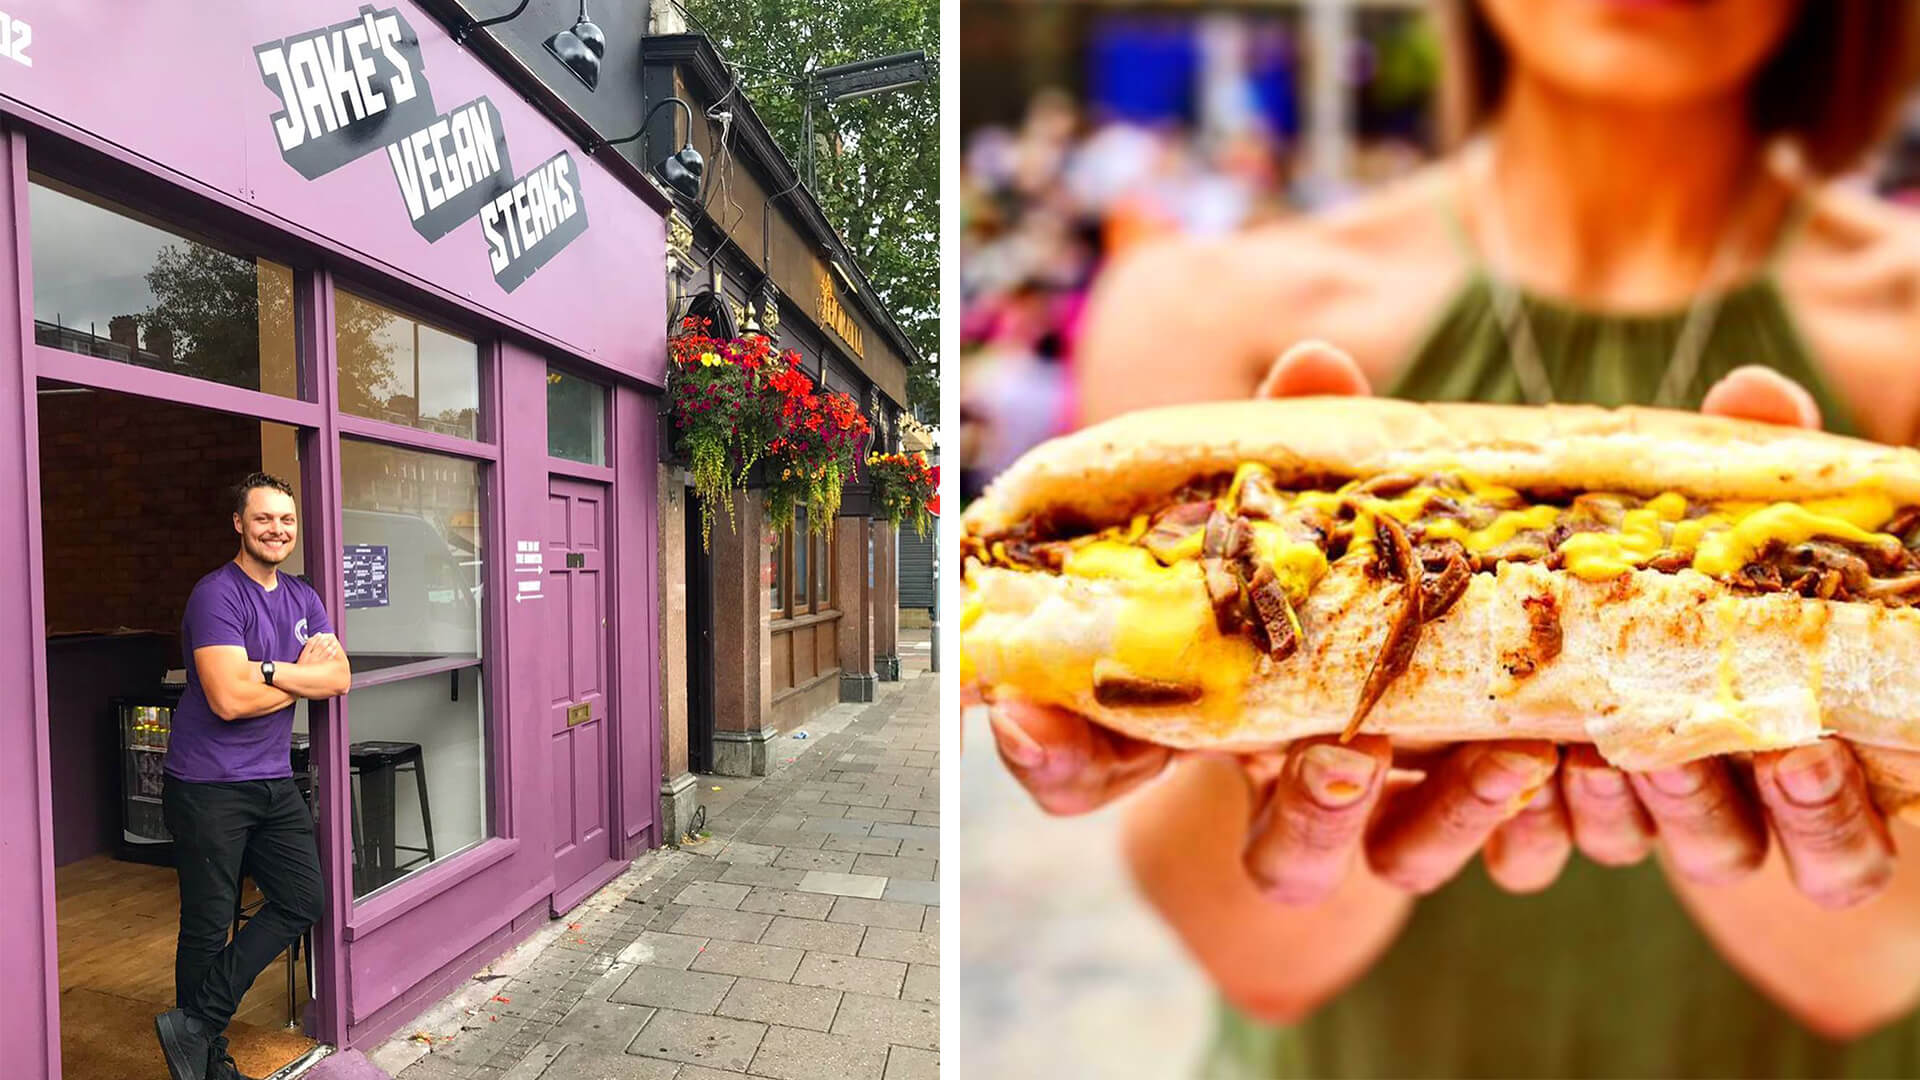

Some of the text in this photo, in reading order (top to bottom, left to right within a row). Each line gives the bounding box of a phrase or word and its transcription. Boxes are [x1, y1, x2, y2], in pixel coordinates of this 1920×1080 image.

[259, 13, 417, 151] JAKE'S
[388, 101, 500, 221] VEGAN
[480, 155, 577, 275] STEAKS
